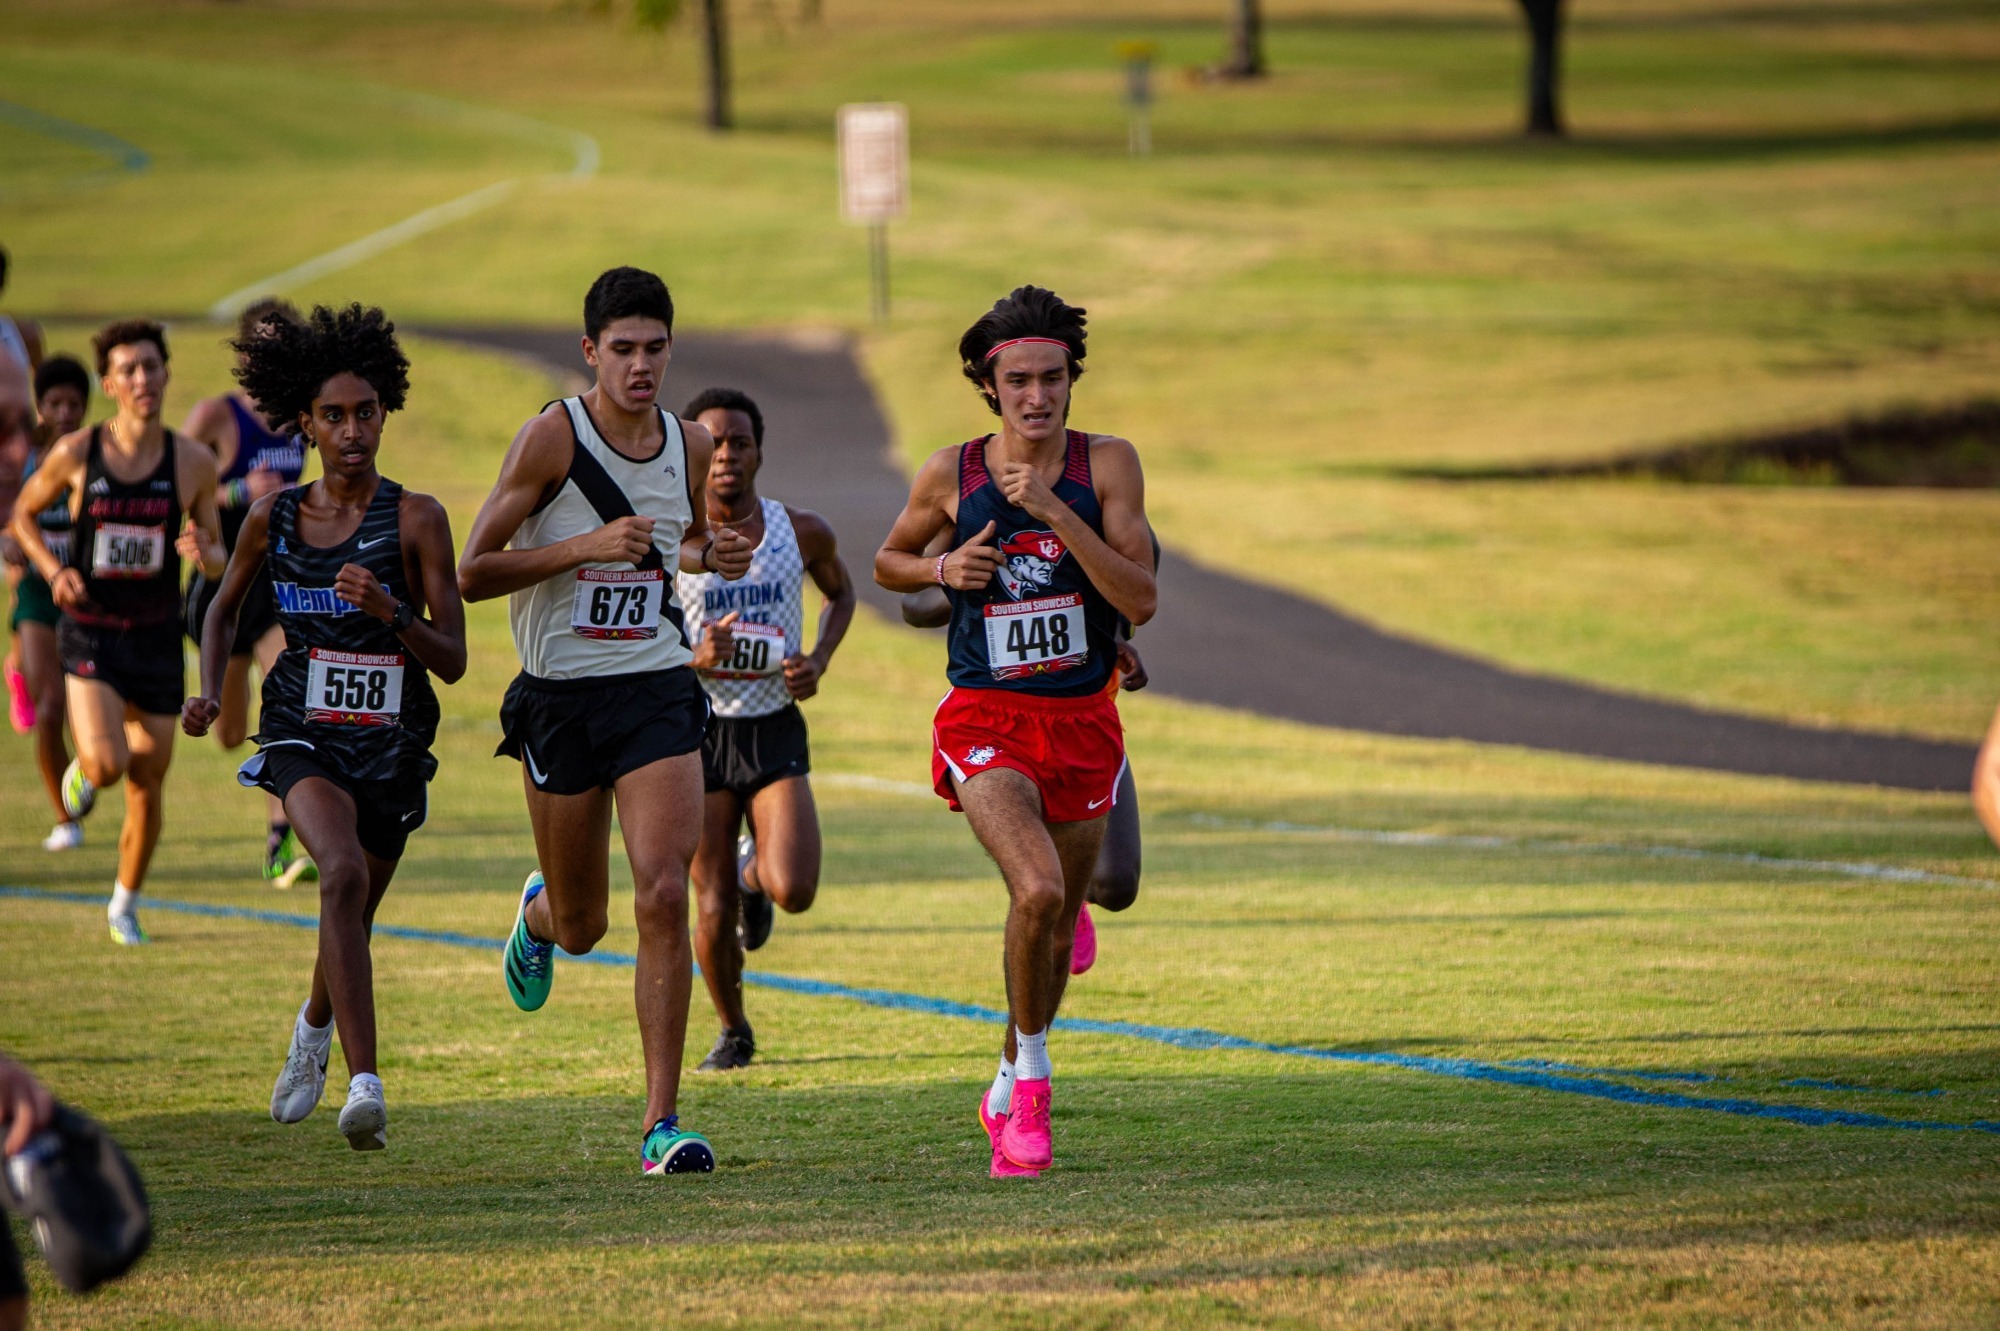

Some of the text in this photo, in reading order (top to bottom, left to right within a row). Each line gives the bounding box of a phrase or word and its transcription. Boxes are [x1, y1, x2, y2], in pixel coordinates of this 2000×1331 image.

[110, 537, 152, 565] 506
[584, 570, 657, 581] SOUTHERN SHOWCASE
[589, 585, 648, 626] 673
[705, 582, 784, 611] DAYTONA
[991, 596, 1076, 616] SOUTHERN SHOWCASE
[1007, 613, 1070, 662] 448
[316, 649, 398, 665] SOUTHERN SHOWCASE
[722, 637, 769, 671] 60
[324, 666, 388, 711] 558
